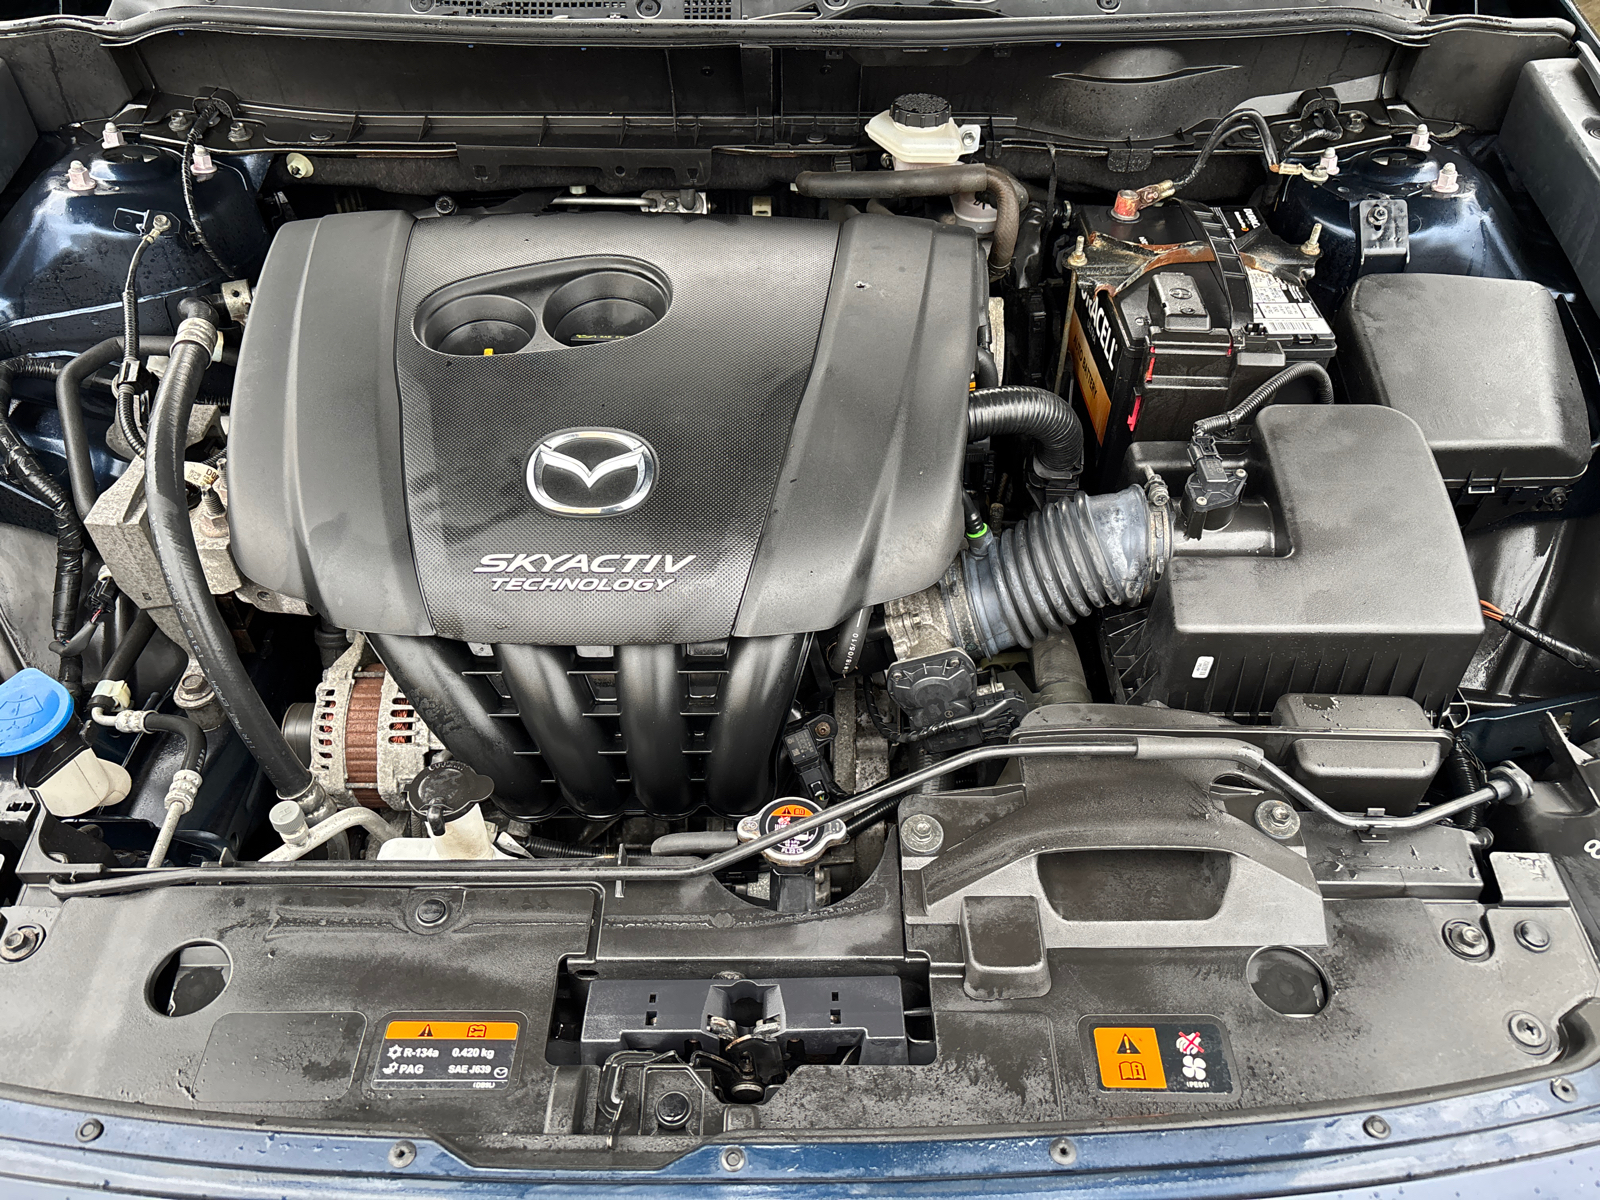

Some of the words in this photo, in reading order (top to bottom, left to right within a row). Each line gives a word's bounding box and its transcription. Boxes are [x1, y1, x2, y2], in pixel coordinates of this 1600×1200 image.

[473, 553, 697, 574] SKYACTIV
[492, 578, 676, 592] TECHNOLOGY
[403, 1048, 439, 1058] R-134a
[452, 1048, 479, 1058] 0.420
[481, 1048, 495, 1059] kg
[399, 1064, 424, 1074] PAG
[448, 1065, 468, 1074] SAE
[469, 1064, 492, 1074] J639
